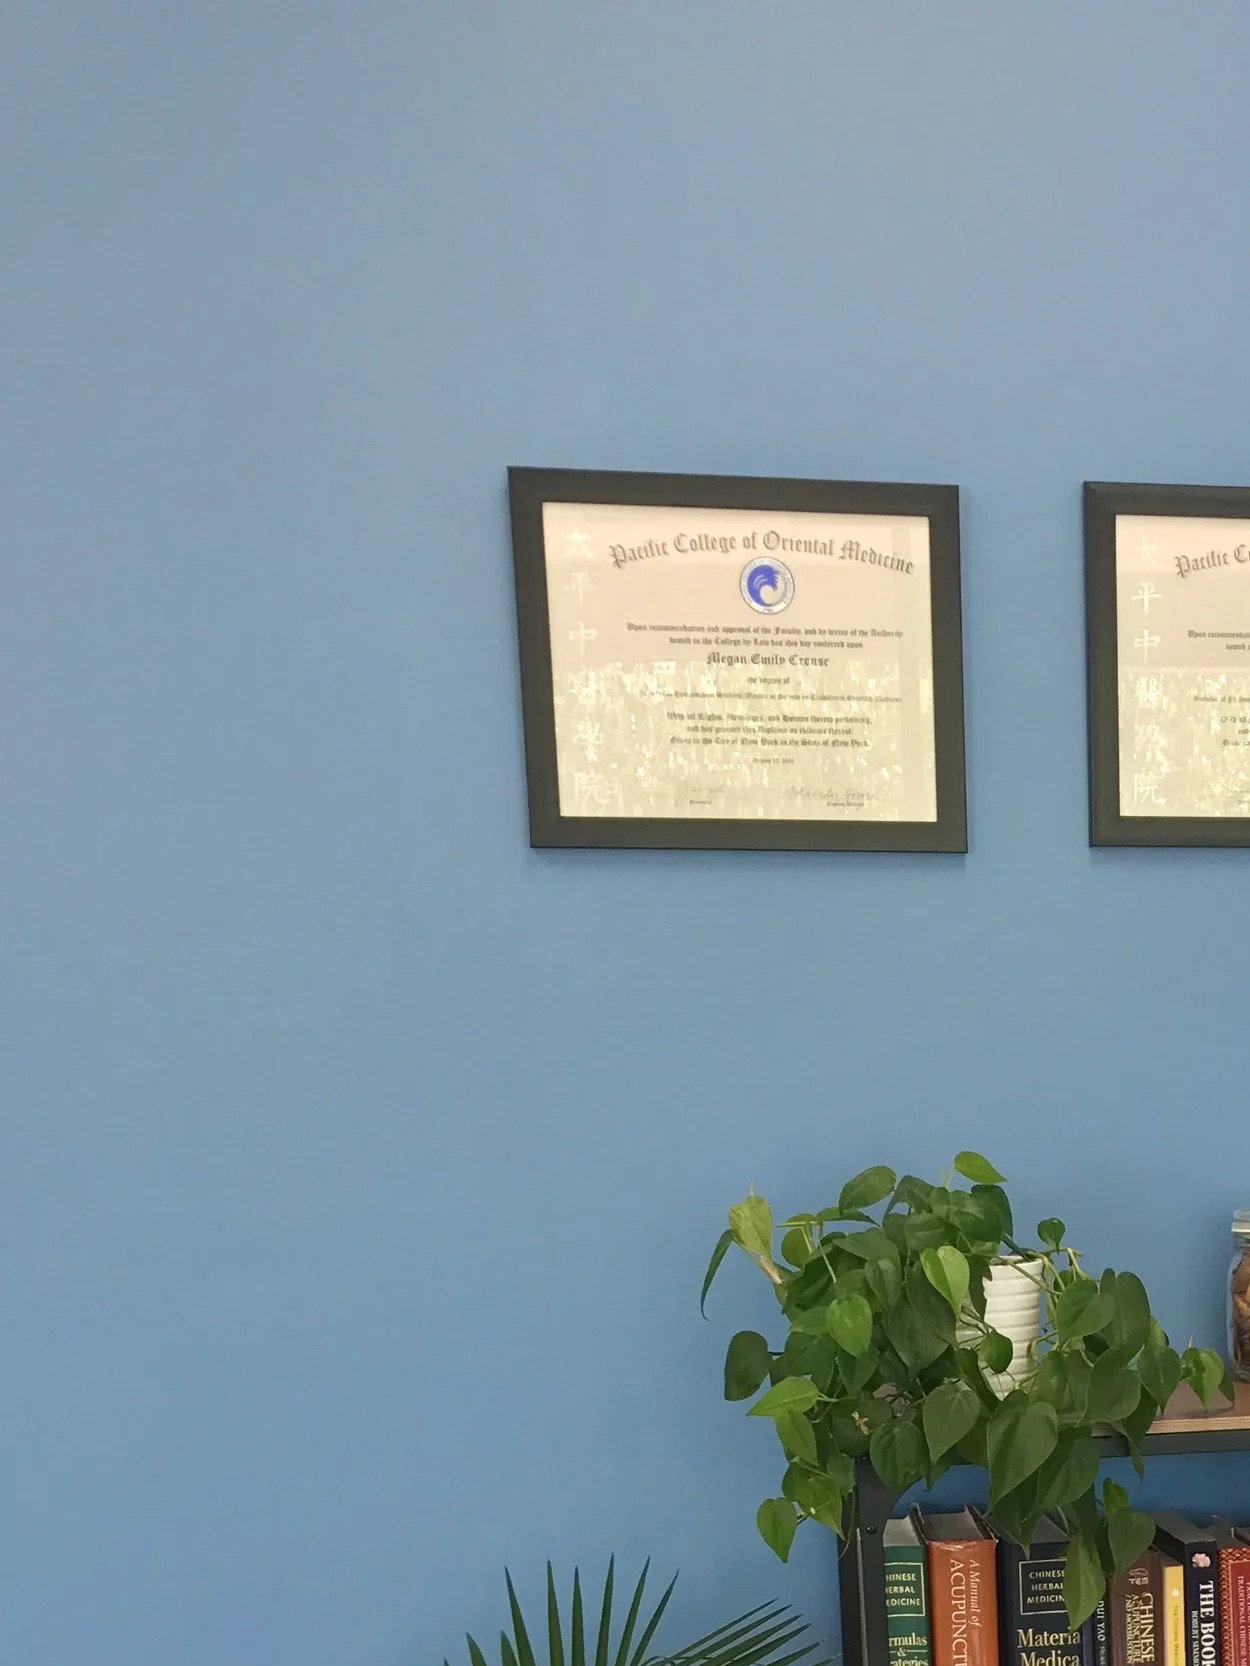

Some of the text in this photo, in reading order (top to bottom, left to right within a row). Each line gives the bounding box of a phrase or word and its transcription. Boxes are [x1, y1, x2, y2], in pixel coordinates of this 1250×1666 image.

[609, 530, 913, 574] Pacific College of Oriental Medicine
[1174, 550, 1229, 579] Pacific
[707, 652, 747, 666] Megan
[750, 653, 785, 668] Emily
[885, 1573, 917, 1581] HINESE
[886, 1598, 921, 1607] EDICINE
[968, 1559, 982, 1628] A Manual of
[1027, 1595, 1065, 1604] MEDICIN
[1199, 1580, 1215, 1618] THE
[1237, 1575, 1246, 1625] TRADITIONAL
[1017, 1626, 1080, 1649] Materia
[1097, 1622, 1106, 1642] YAO
[1131, 1594, 1141, 1663] ACUPUNCTURE
[1140, 1592, 1155, 1663] CHINESE
[1191, 1610, 1199, 1639] ROBERT
[888, 1632, 928, 1647] rmulas
[897, 1647, 907, 1657] &
[1239, 1625, 1247, 1656] CHINESE
